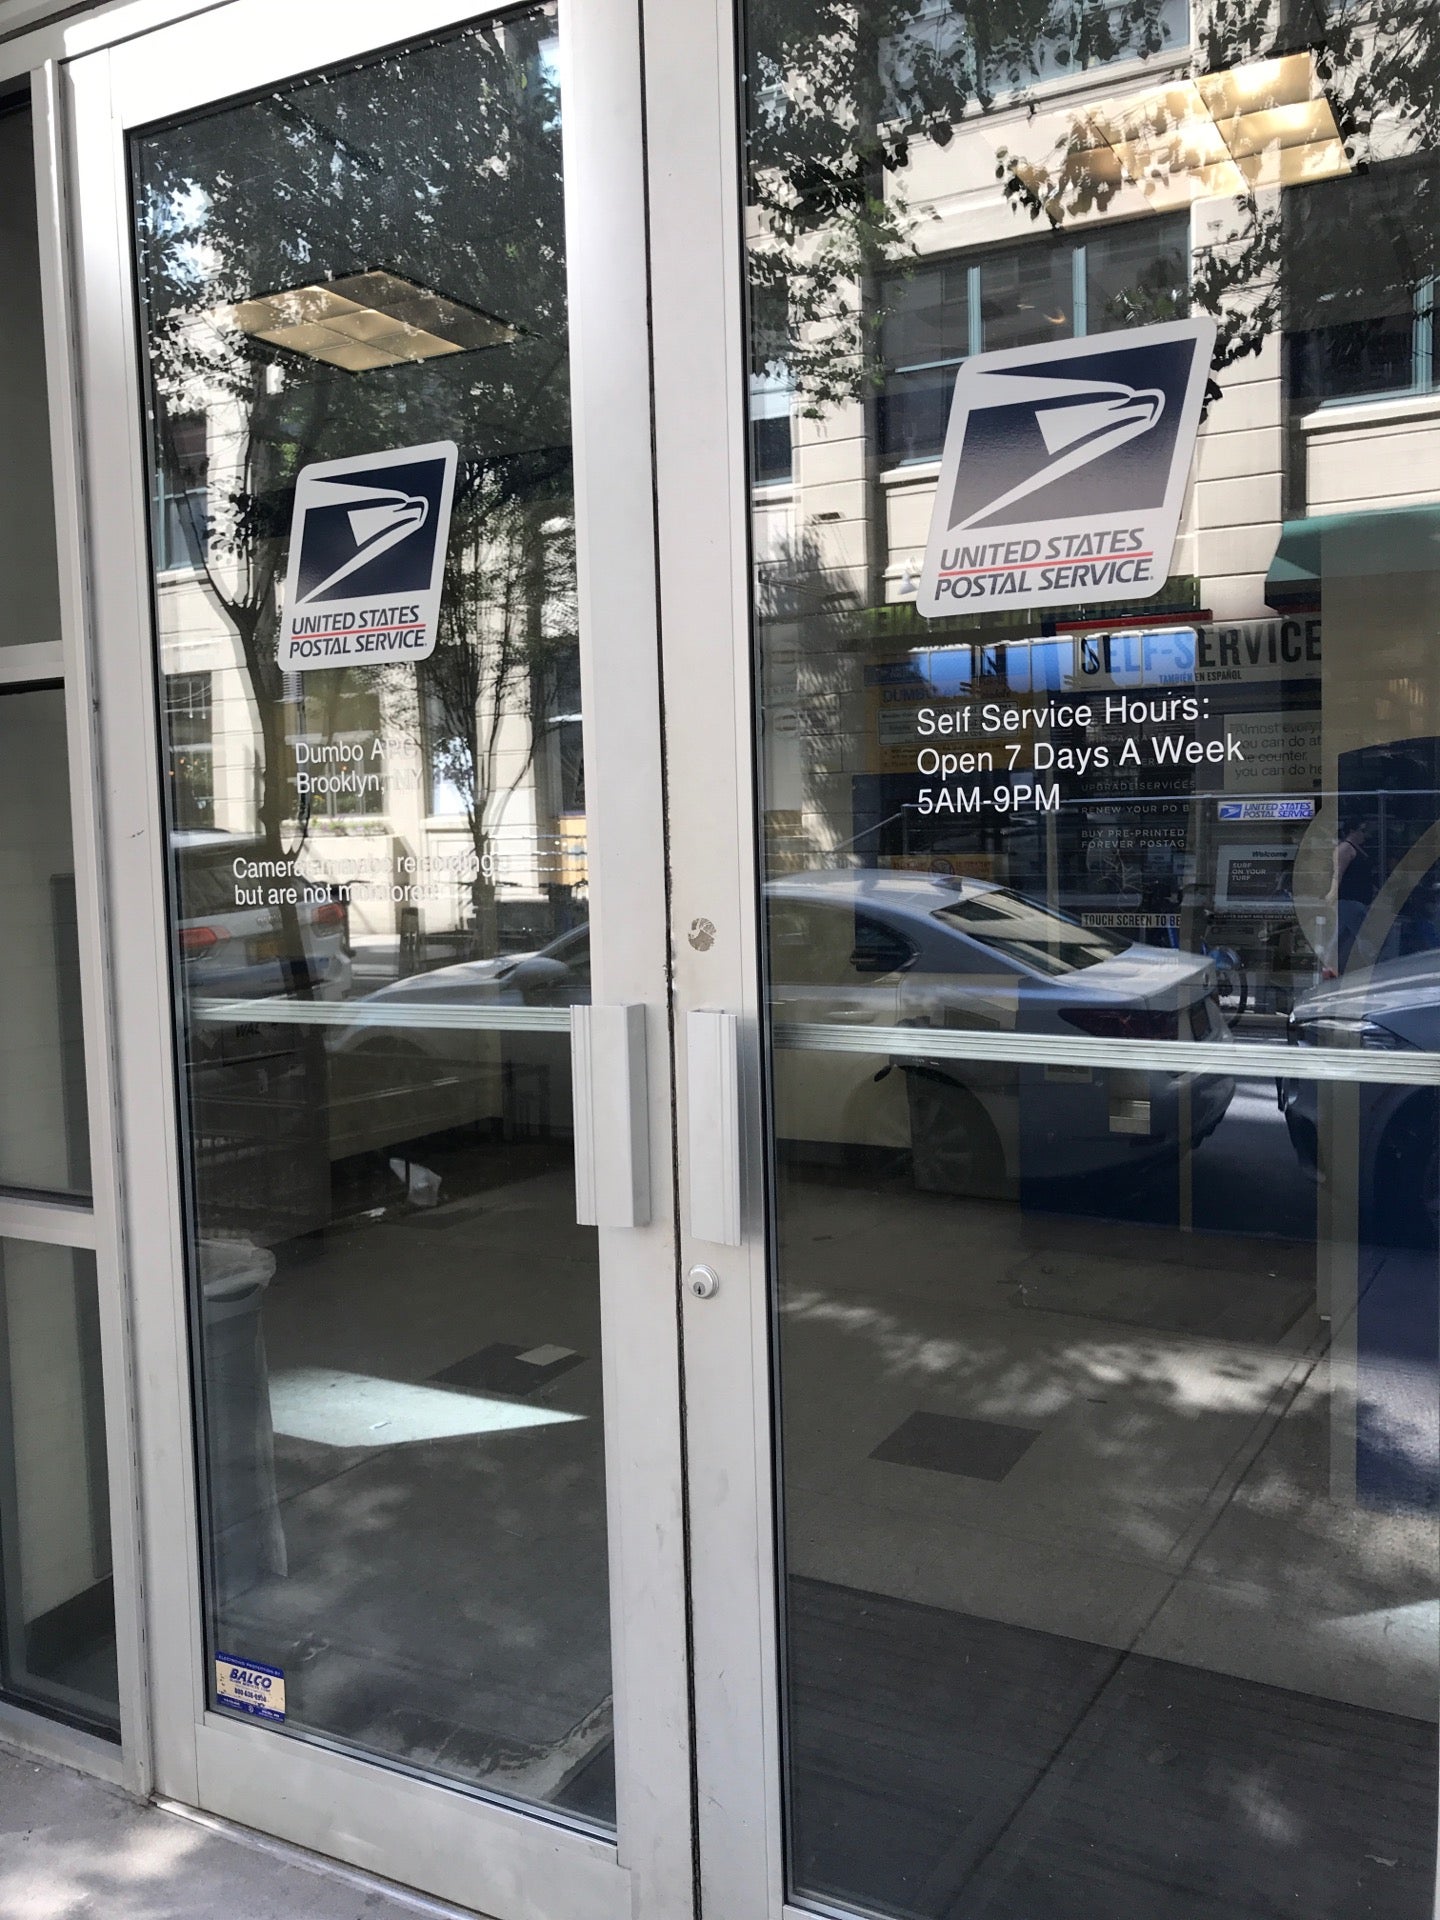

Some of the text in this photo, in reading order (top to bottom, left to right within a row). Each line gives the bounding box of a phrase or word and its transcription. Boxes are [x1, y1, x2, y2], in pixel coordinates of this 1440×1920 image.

[940, 527, 1144, 571] UNITED STATES
[934, 558, 1152, 601] POSTAL SERVICE
[292, 605, 420, 635] UNITED STATES
[289, 629, 426, 659] POSTAL SERVICE
[1081, 619, 1321, 675] SELF-SERVICE
[1195, 671, 1206, 682] EN
[1207, 667, 1242, 681] ESPAÑOL
[917, 706, 971, 735] Self
[982, 700, 1093, 732] Service
[1105, 696, 1210, 724] Hours:
[295, 740, 364, 764] Dumbo
[1261, 738, 1285, 748] can
[1288, 736, 1307, 747] do
[917, 748, 993, 781] Open
[1005, 744, 1021, 771] 7
[1034, 742, 1109, 776] Days
[1118, 737, 1142, 766] A
[1151, 733, 1245, 764] Week
[1235, 768, 1258, 781] you
[1261, 766, 1285, 777] can
[1288, 764, 1307, 776] do
[296, 771, 385, 797] Brooklyn,
[917, 784, 1060, 814] 5AM-9PM
[1081, 805, 1122, 814] RENEW
[1126, 804, 1157, 813] YOUR
[1162, 804, 1178, 813] PO
[1244, 802, 1312, 811] UNITED STATES
[1278, 809, 1314, 818] SERVICE
[1081, 828, 1185, 838] BUY PRE-PRINTED
[1081, 839, 1133, 849] FOREVER
[234, 884, 263, 905] but
[268, 886, 297, 905] are
[303, 883, 333, 904] not
[1084, 914, 1181, 927] TOUCH SCREEN TO BE
[230, 1668, 272, 1689] BALCO
